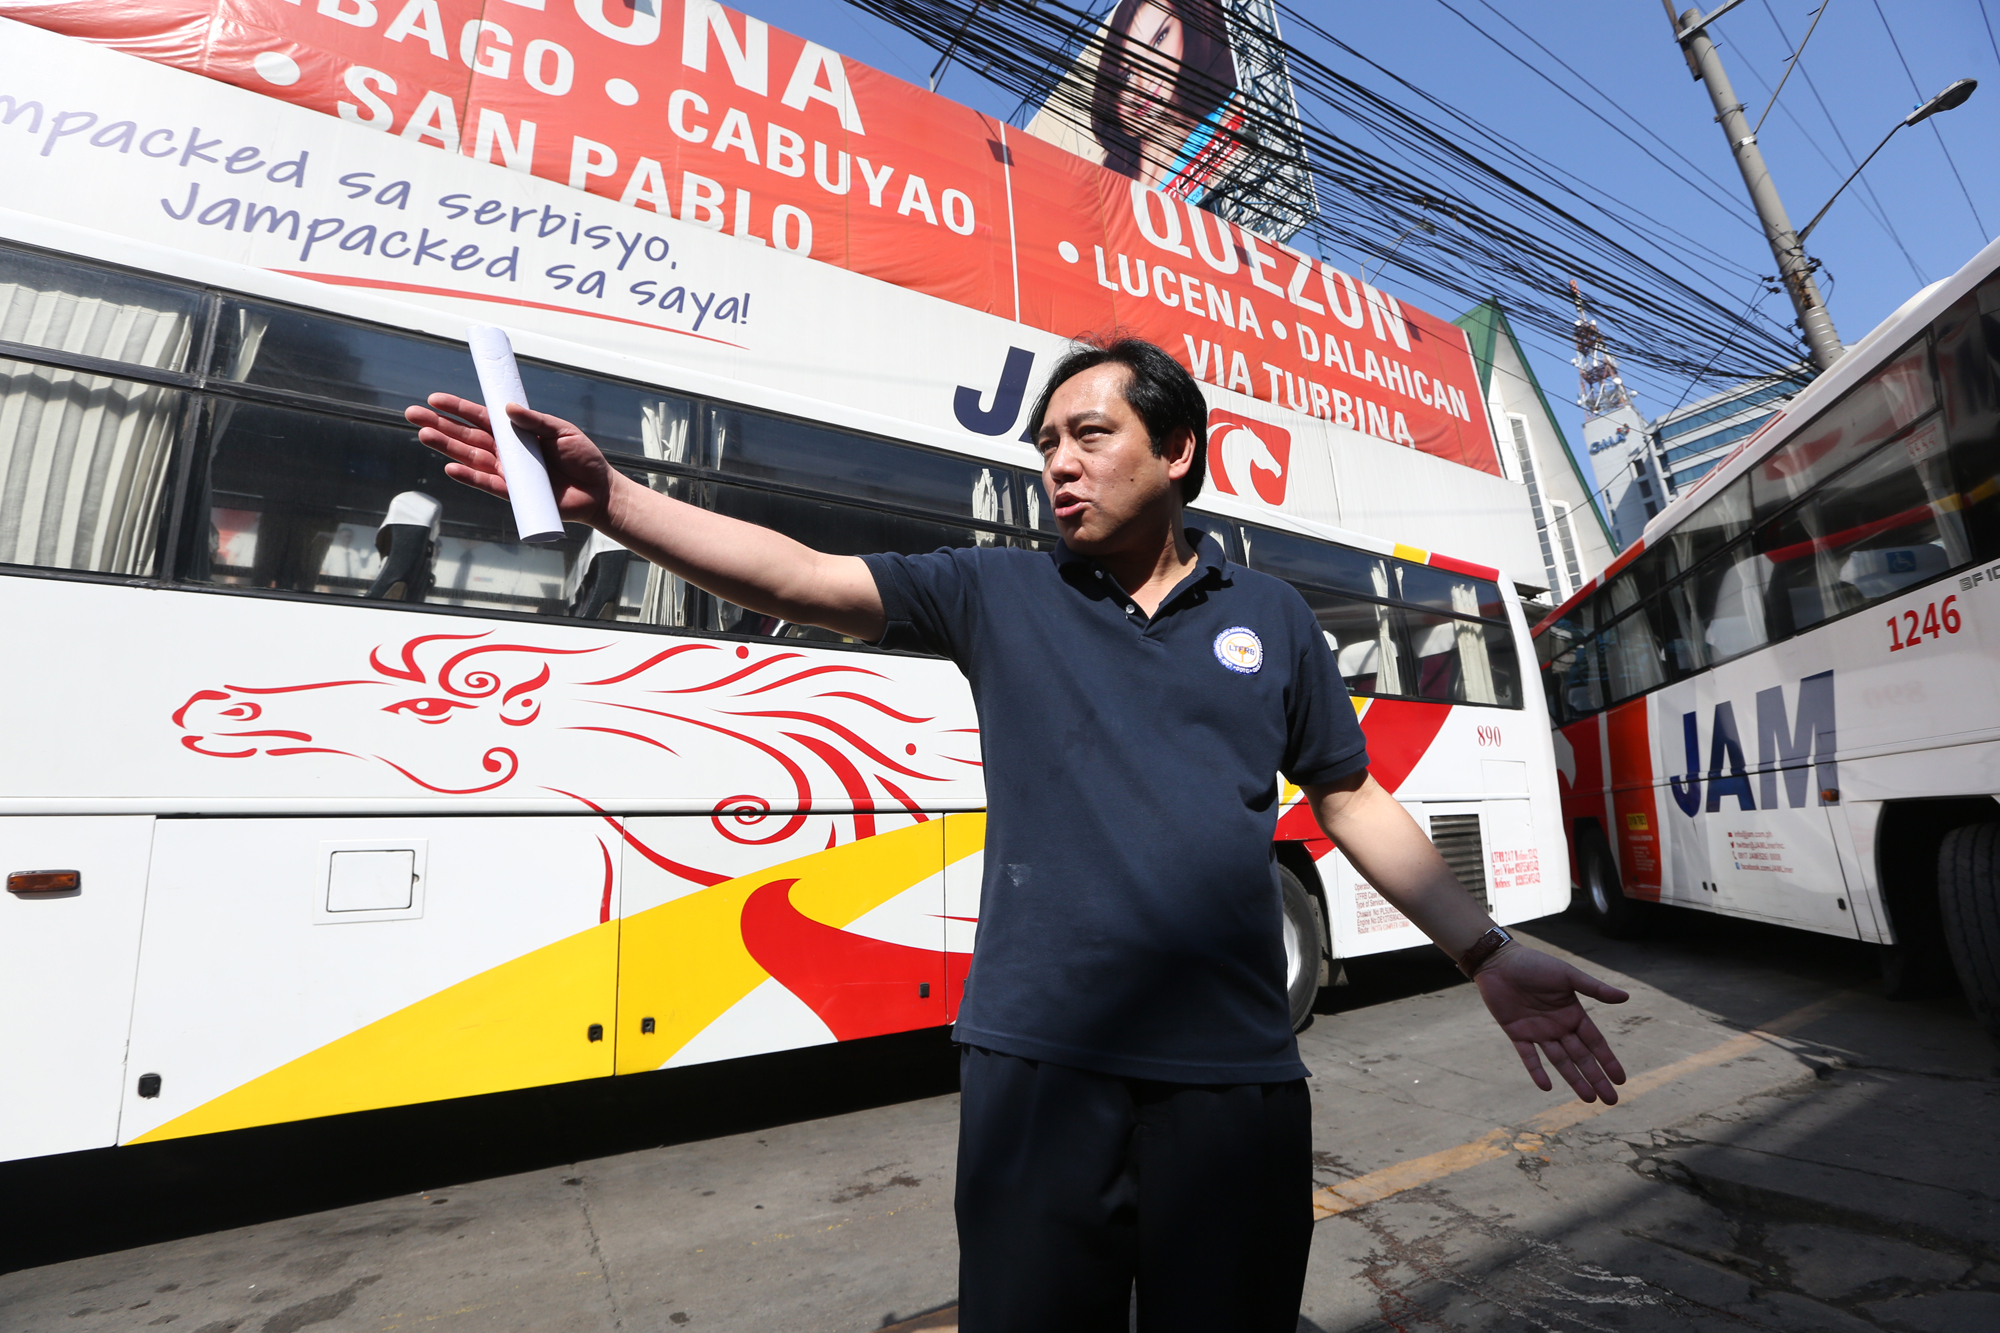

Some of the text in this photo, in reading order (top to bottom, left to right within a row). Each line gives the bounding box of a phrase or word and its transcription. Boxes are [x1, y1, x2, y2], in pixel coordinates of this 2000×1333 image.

[337, 65, 813, 258] SAN PABLO
[339, 172, 411, 210] sa
[437, 192, 678, 271] serbisyo.
[668, 89, 976, 236] CABUYAO
[160, 182, 751, 331] Jampacked sa saya!
[1130, 181, 1411, 353] QUEZON
[1094, 244, 1471, 422] LUCENA DALAHICAN
[1183, 334, 1416, 450] VIA TURBINA
[1229, 645, 1255, 656] LTFRB
[1886, 594, 1962, 653] 1246
[1476, 725, 1502, 747] 890
[1670, 668, 1840, 819] JAM
